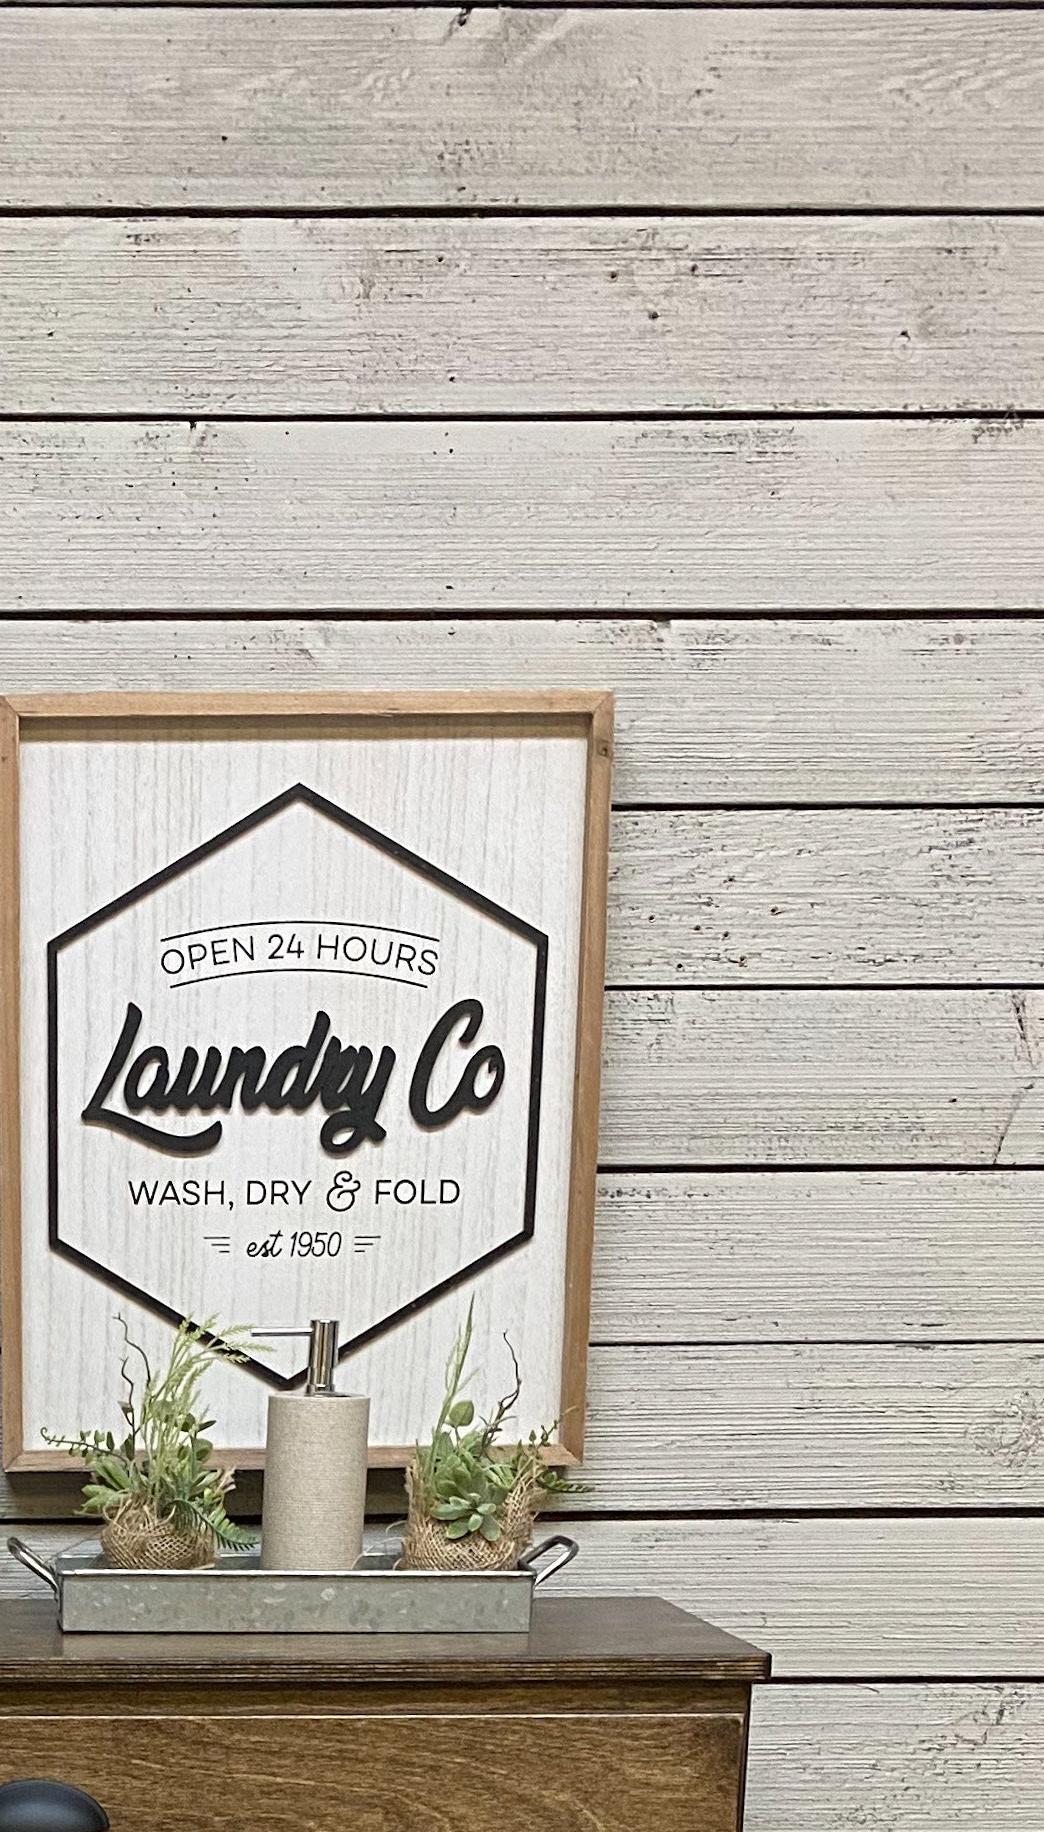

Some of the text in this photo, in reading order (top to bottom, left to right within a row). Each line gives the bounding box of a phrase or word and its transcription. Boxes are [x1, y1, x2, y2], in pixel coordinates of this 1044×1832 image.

[159, 932, 440, 977] OPEN 24 HOURS
[80, 998, 506, 1160] Laundry Co
[128, 1170, 461, 1213] WASH, DRY & FOLD
[245, 1229, 343, 1259] est 1950
